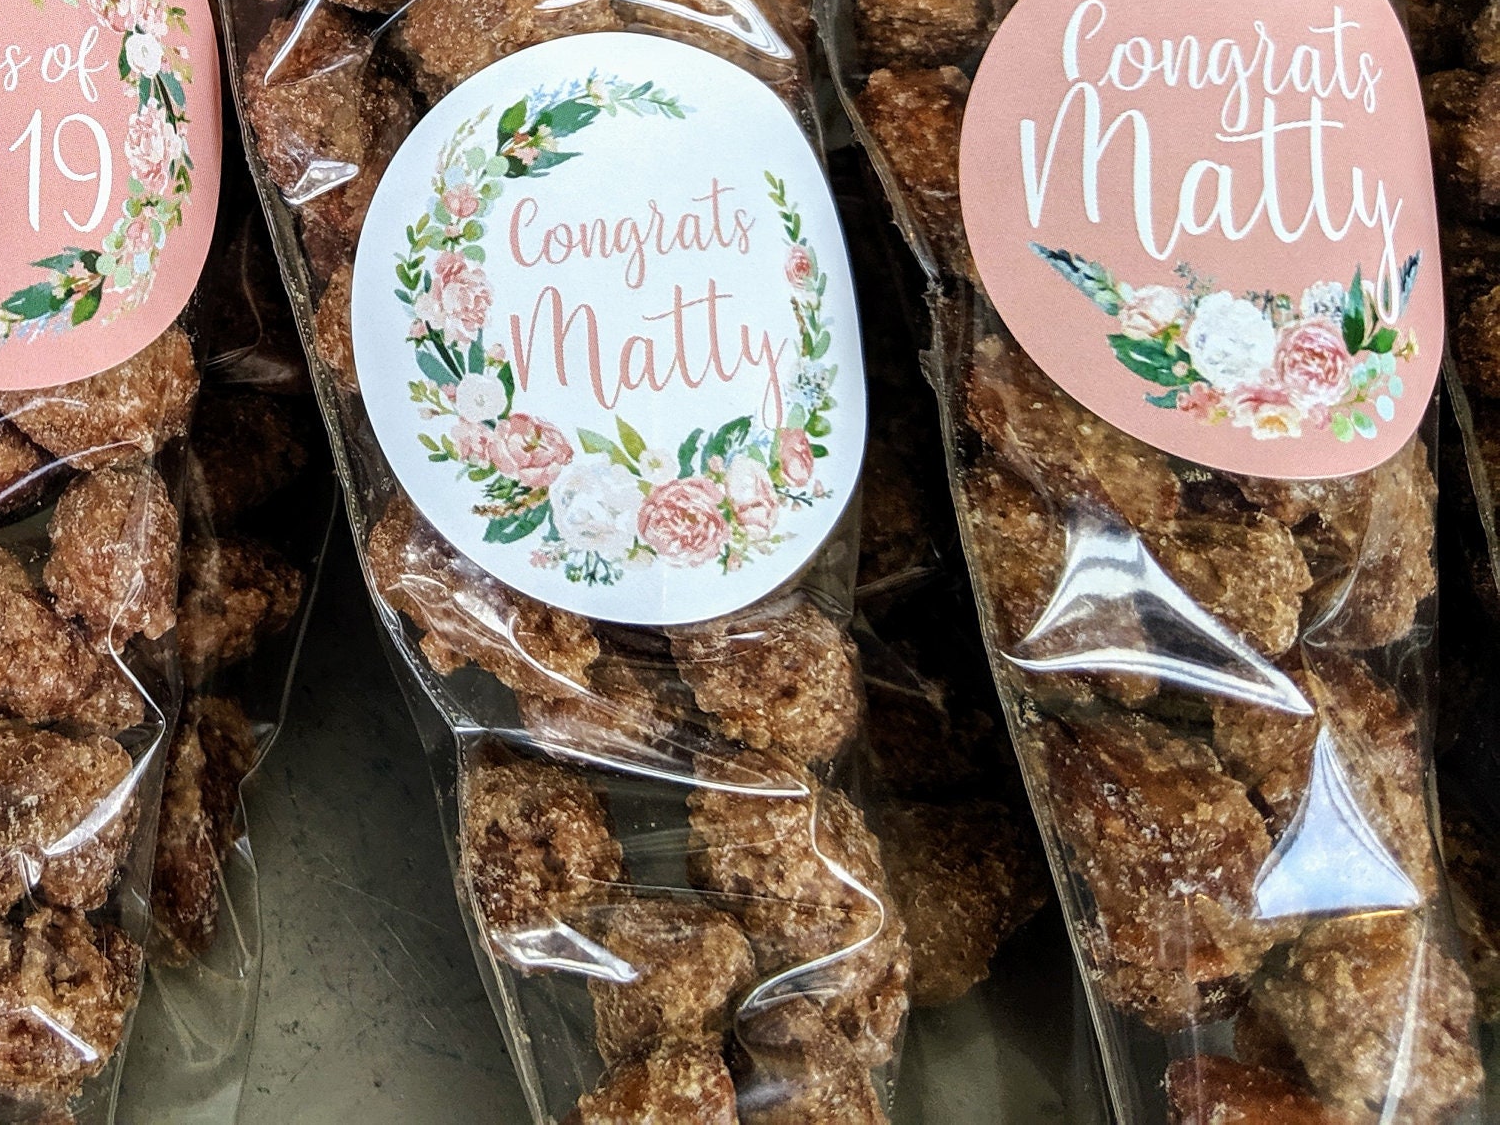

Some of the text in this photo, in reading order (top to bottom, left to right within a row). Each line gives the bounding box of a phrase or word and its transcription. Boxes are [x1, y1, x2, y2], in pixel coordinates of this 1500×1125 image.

[41, 25, 109, 103] of
[508, 178, 756, 290] Congrats
[1019, 81, 1404, 325] Matty
[509, 278, 787, 429] Matty
